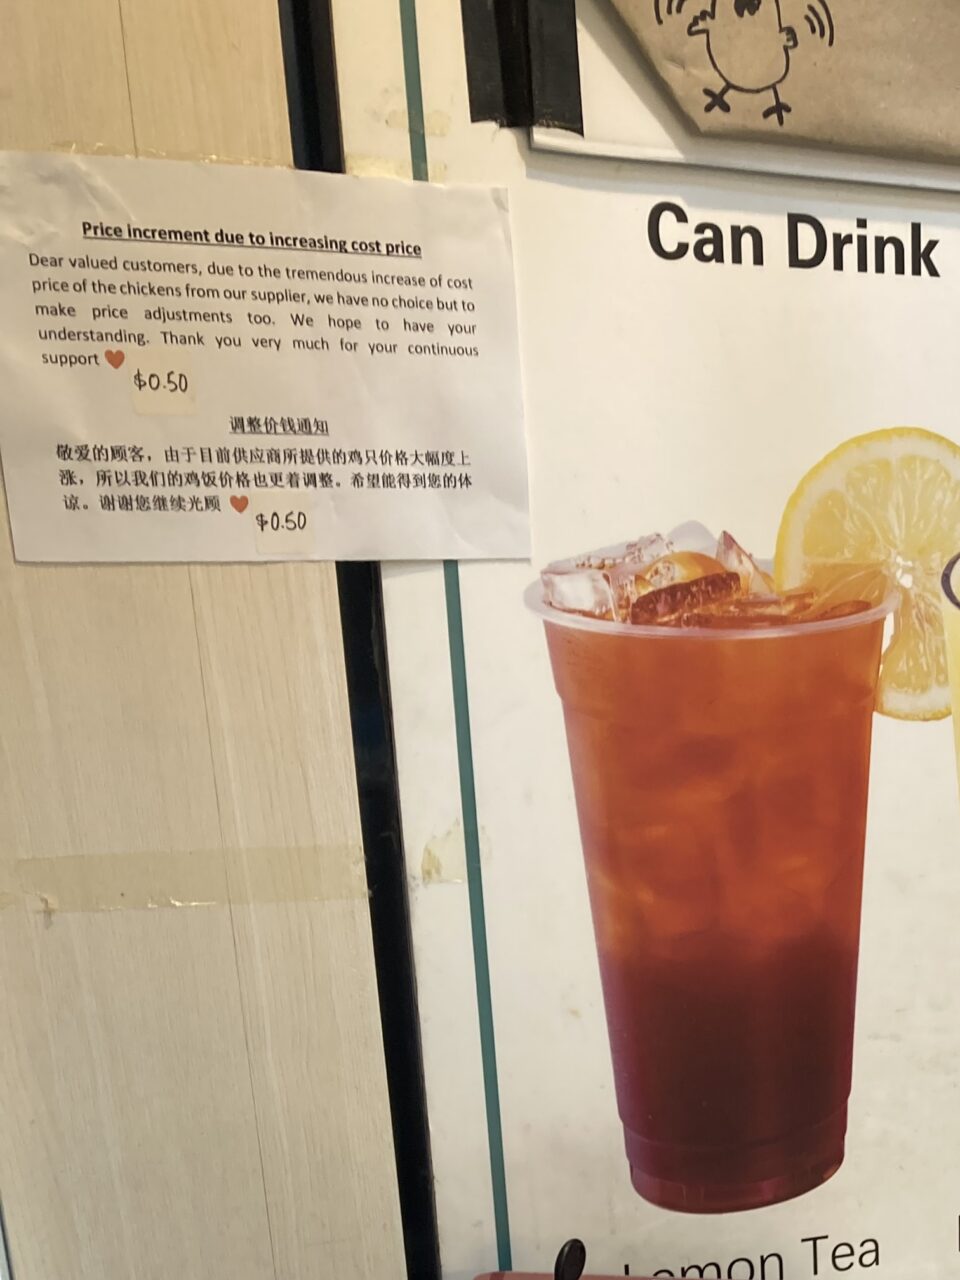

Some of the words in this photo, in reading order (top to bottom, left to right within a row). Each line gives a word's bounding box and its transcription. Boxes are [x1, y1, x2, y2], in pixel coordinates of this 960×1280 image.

[82, 221, 122, 239] Price
[127, 223, 210, 243] increment
[214, 228, 244, 244] due
[249, 232, 265, 246] to
[269, 232, 348, 253] increasing
[351, 240, 382, 255] cost
[385, 240, 422, 257] price
[646, 201, 764, 267] Can
[787, 211, 941, 278] Drink
[29, 252, 64, 268] Dear
[68, 254, 118, 270] valued
[122, 258, 202, 276] customers,
[207, 261, 235, 276] due
[238, 264, 254, 277] to
[257, 264, 281, 279] the
[285, 266, 368, 284] tremendous
[371, 270, 426, 287] increase
[429, 273, 443, 288] of
[446, 276, 473, 290] cost
[32, 279, 69, 294] price
[72, 278, 88, 293] of
[92, 280, 117, 295] the
[119, 281, 182, 298] chickens
[185, 283, 220, 299] from
[223, 288, 247, 300] our
[251, 288, 311, 305] supplier,
[314, 293, 334, 304] we
[337, 292, 369, 307] have
[371, 297, 389, 308] no
[391, 295, 434, 310] choice
[436, 297, 458, 311] but
[461, 300, 475, 312] to
[35, 302, 76, 317] make
[92, 305, 129, 320] price
[144, 306, 233, 328] adjustments
[247, 311, 276, 326] too.
[290, 313, 314, 327] We
[327, 314, 362, 331] hope
[375, 318, 390, 331] to
[403, 318, 435, 333] have
[447, 322, 477, 337] your
[38, 327, 150, 347] understanding.
[160, 329, 205, 346] Thank
[215, 335, 242, 349] you
[252, 336, 281, 352] very
[292, 336, 330, 351] much
[339, 337, 358, 352] for
[368, 341, 398, 356] your
[408, 342, 479, 357] continuous
[41, 350, 100, 368] support
[133, 368, 189, 393] $0.50
[229, 415, 329, 434] 调整价钱通知
[255, 511, 307, 532] $0.50
[801, 1234, 880, 1276] Tea
